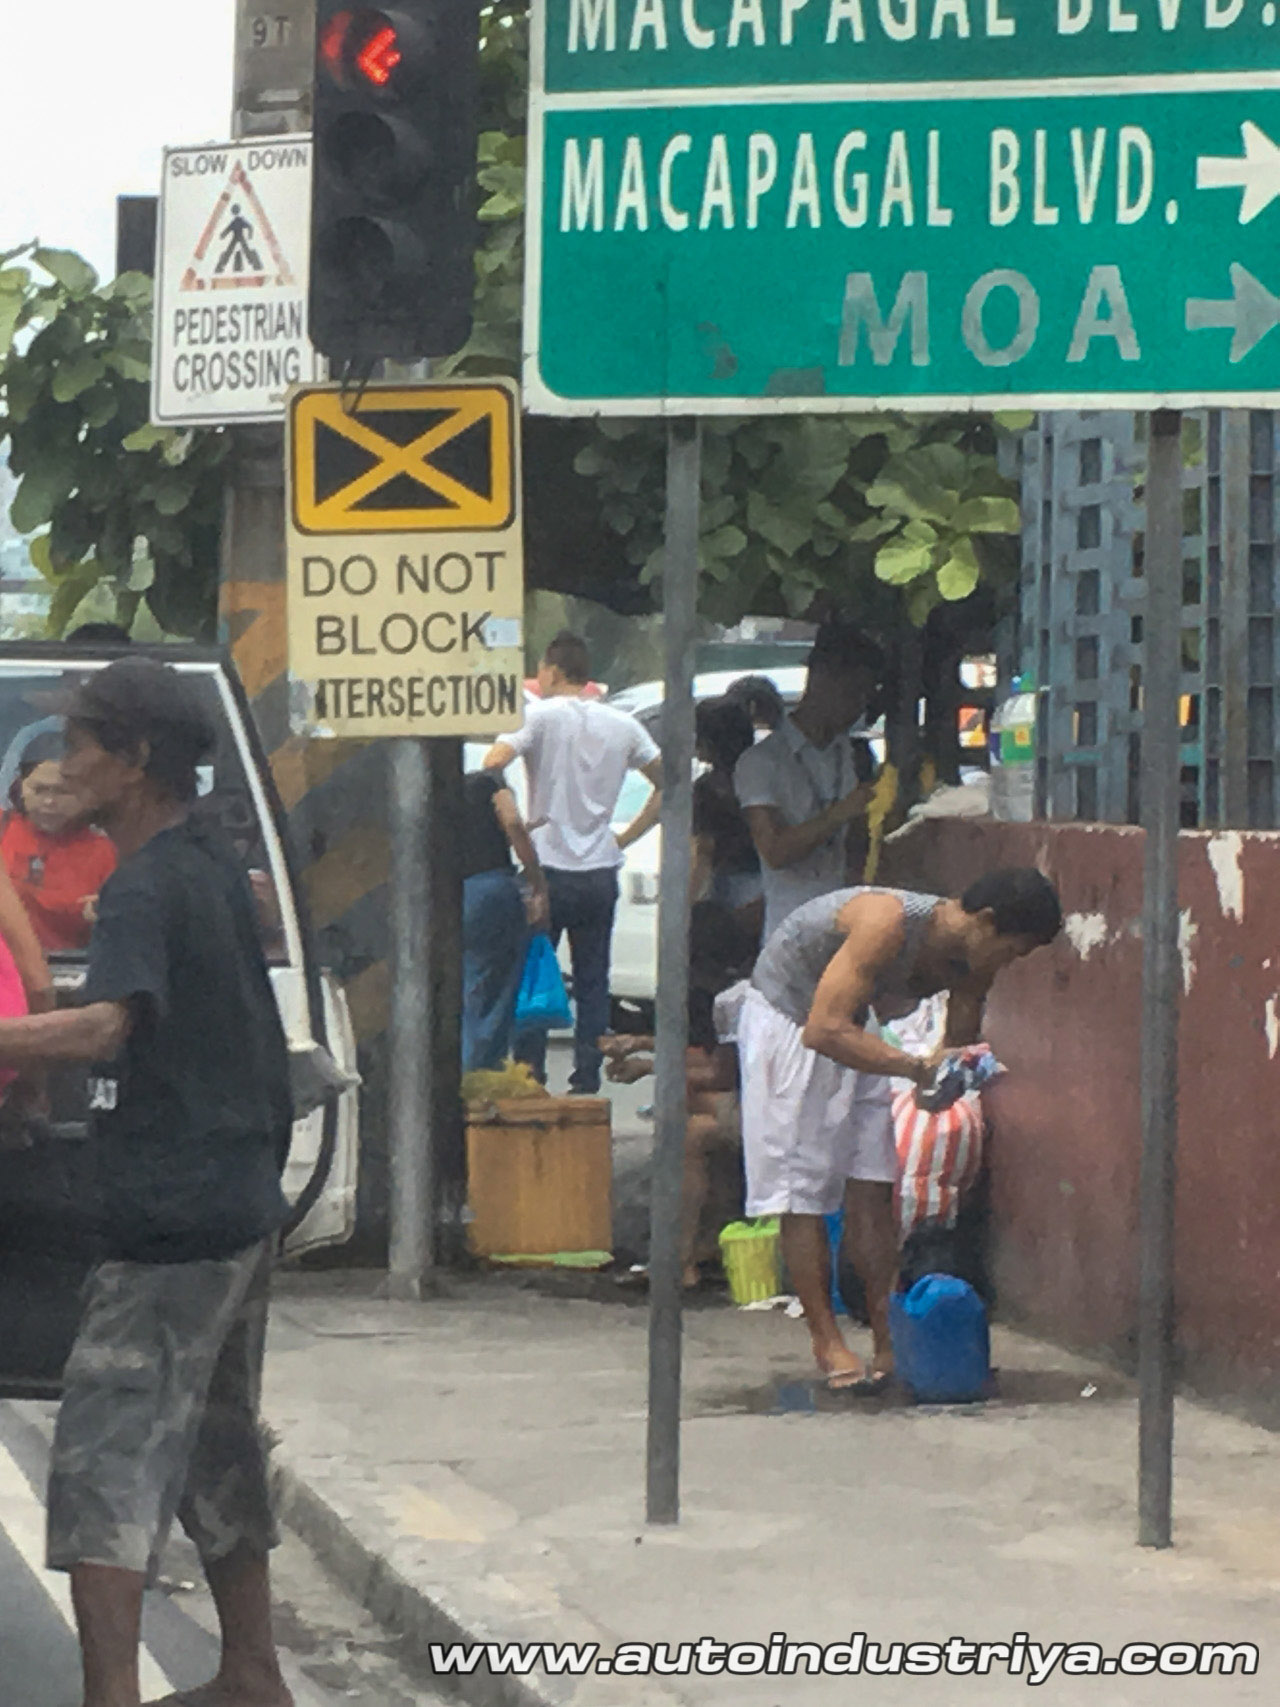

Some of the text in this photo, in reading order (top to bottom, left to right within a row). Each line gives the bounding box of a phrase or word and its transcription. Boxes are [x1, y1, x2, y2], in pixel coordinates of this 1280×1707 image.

[170, 148, 308, 177] SLOW DOWN
[559, 125, 1179, 233] MACAPAGAL BLVD.
[173, 300, 303, 348] PEDESTRIAN
[837, 264, 1142, 367] MOA
[173, 347, 302, 392] CROSSING
[302, 551, 507, 597] DO NOT
[315, 611, 493, 655] BLOCK
[314, 674, 518, 721] NTERSECTION
